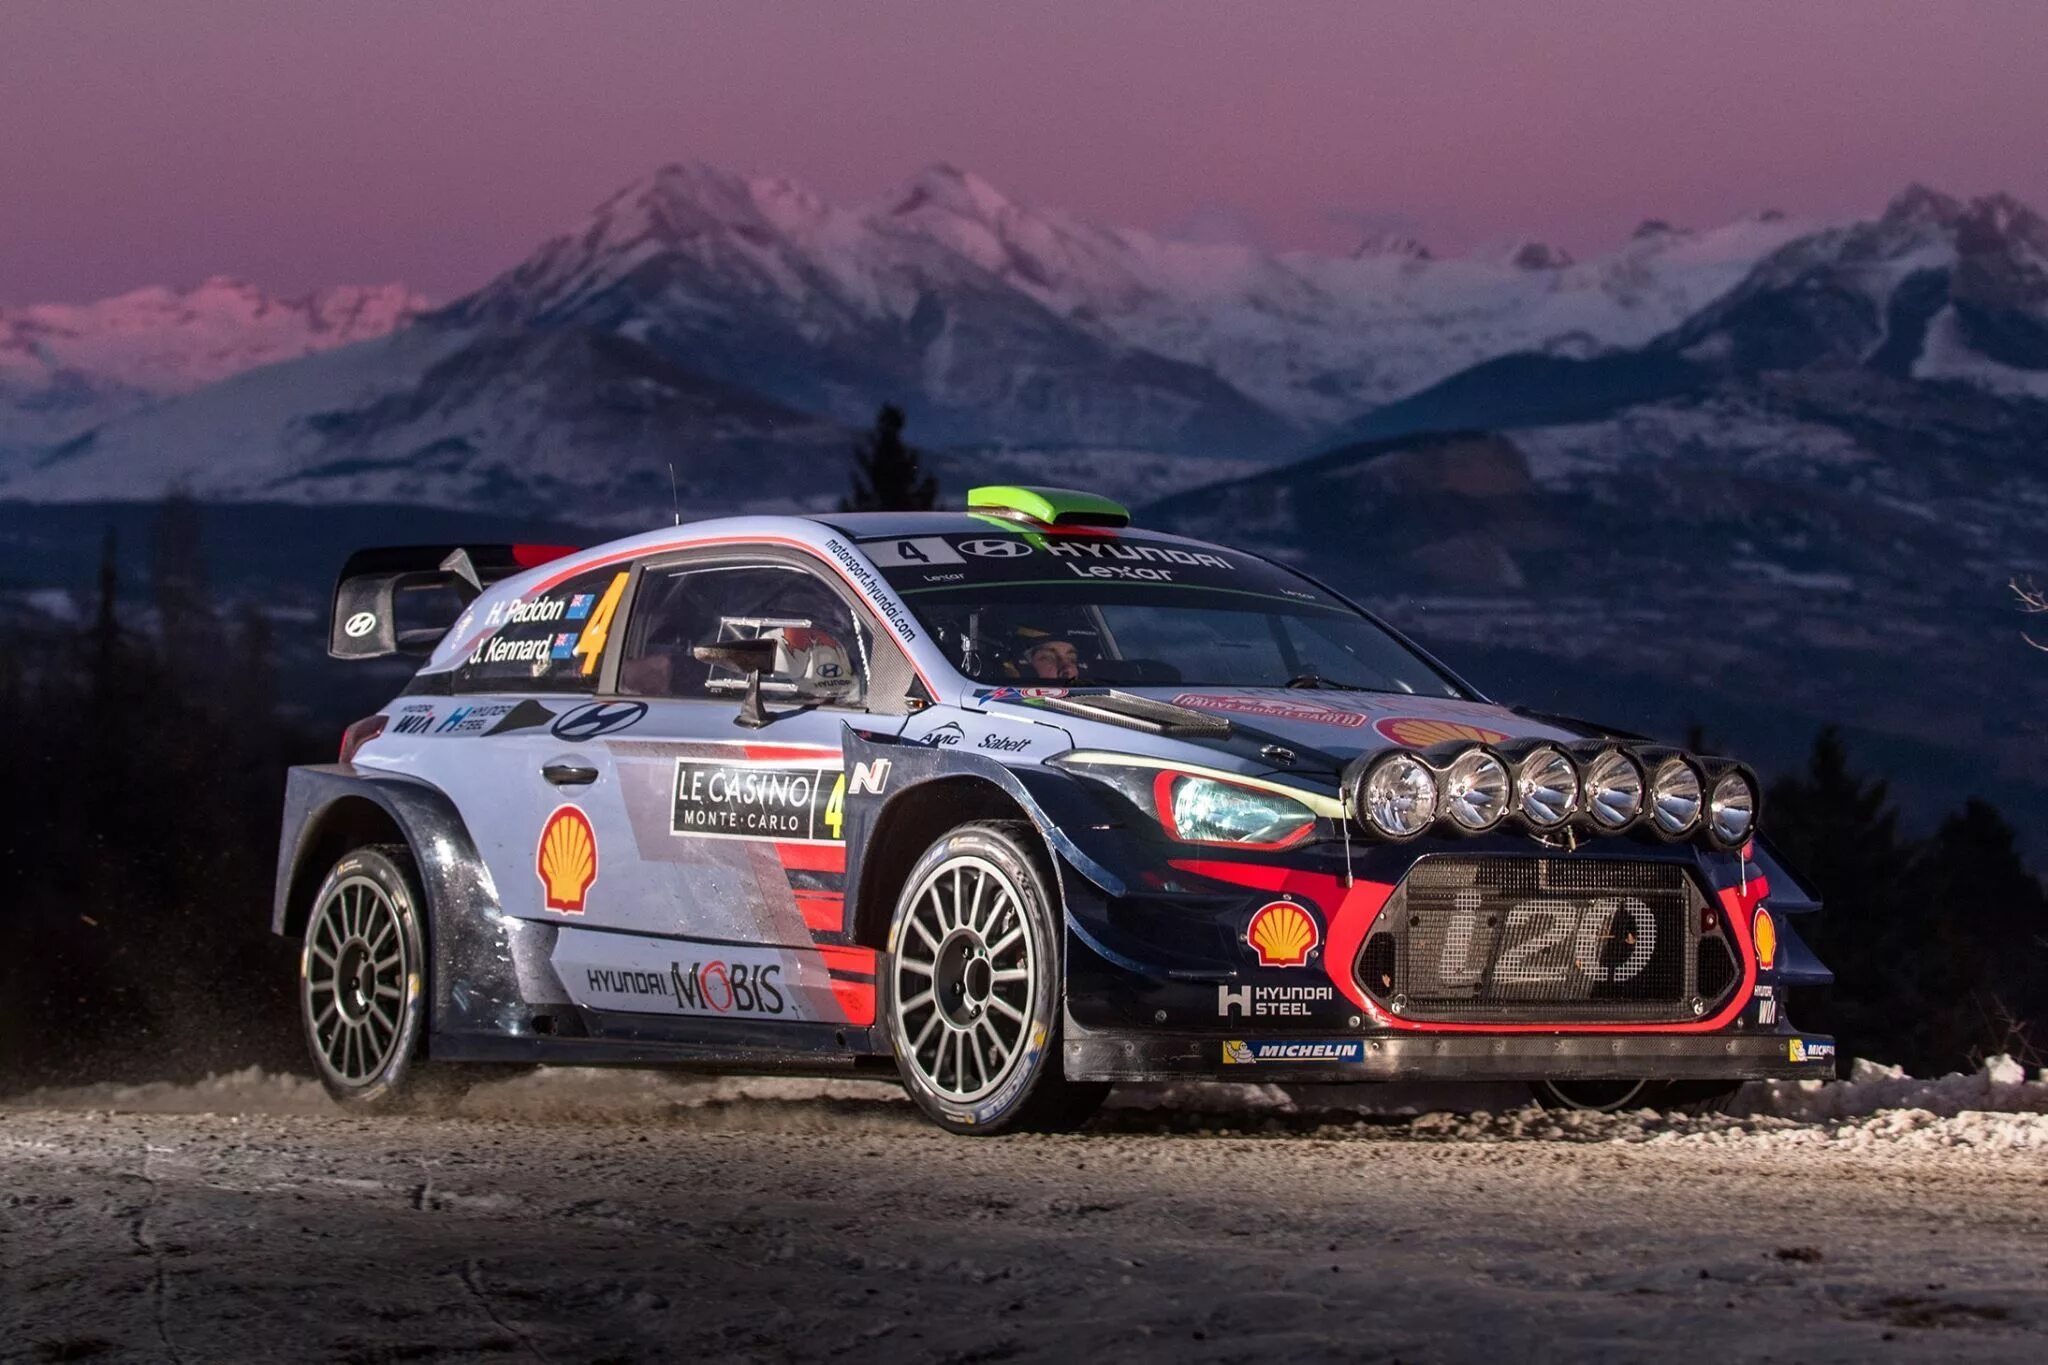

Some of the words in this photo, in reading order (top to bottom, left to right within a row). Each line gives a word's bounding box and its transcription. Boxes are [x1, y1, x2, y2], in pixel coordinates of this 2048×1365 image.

[897, 541, 930, 562] 4
[1044, 541, 1236, 570] HYUNDAI
[1066, 561, 1173, 581] Lexar
[825, 539, 916, 643] motorsport.hyundai.com
[485, 602, 501, 626] H.
[502, 596, 565, 624] Paddon
[577, 572, 630, 675] 4
[469, 637, 484, 665] J.
[484, 633, 554, 662] Kennard
[920, 733, 961, 745] AMG
[978, 733, 1032, 752] Sabelt
[679, 770, 704, 801] LE
[709, 772, 810, 808] CASINO
[824, 773, 845, 839] 4
[1439, 888, 1657, 983] i20
[586, 968, 668, 996] HYUNDAI
[670, 959, 784, 1014] MOBIS
[1256, 987, 1333, 1000] HYUNDAI
[1256, 1003, 1312, 1016] STEEL
[1258, 1045, 1358, 1057] MICHELIN
